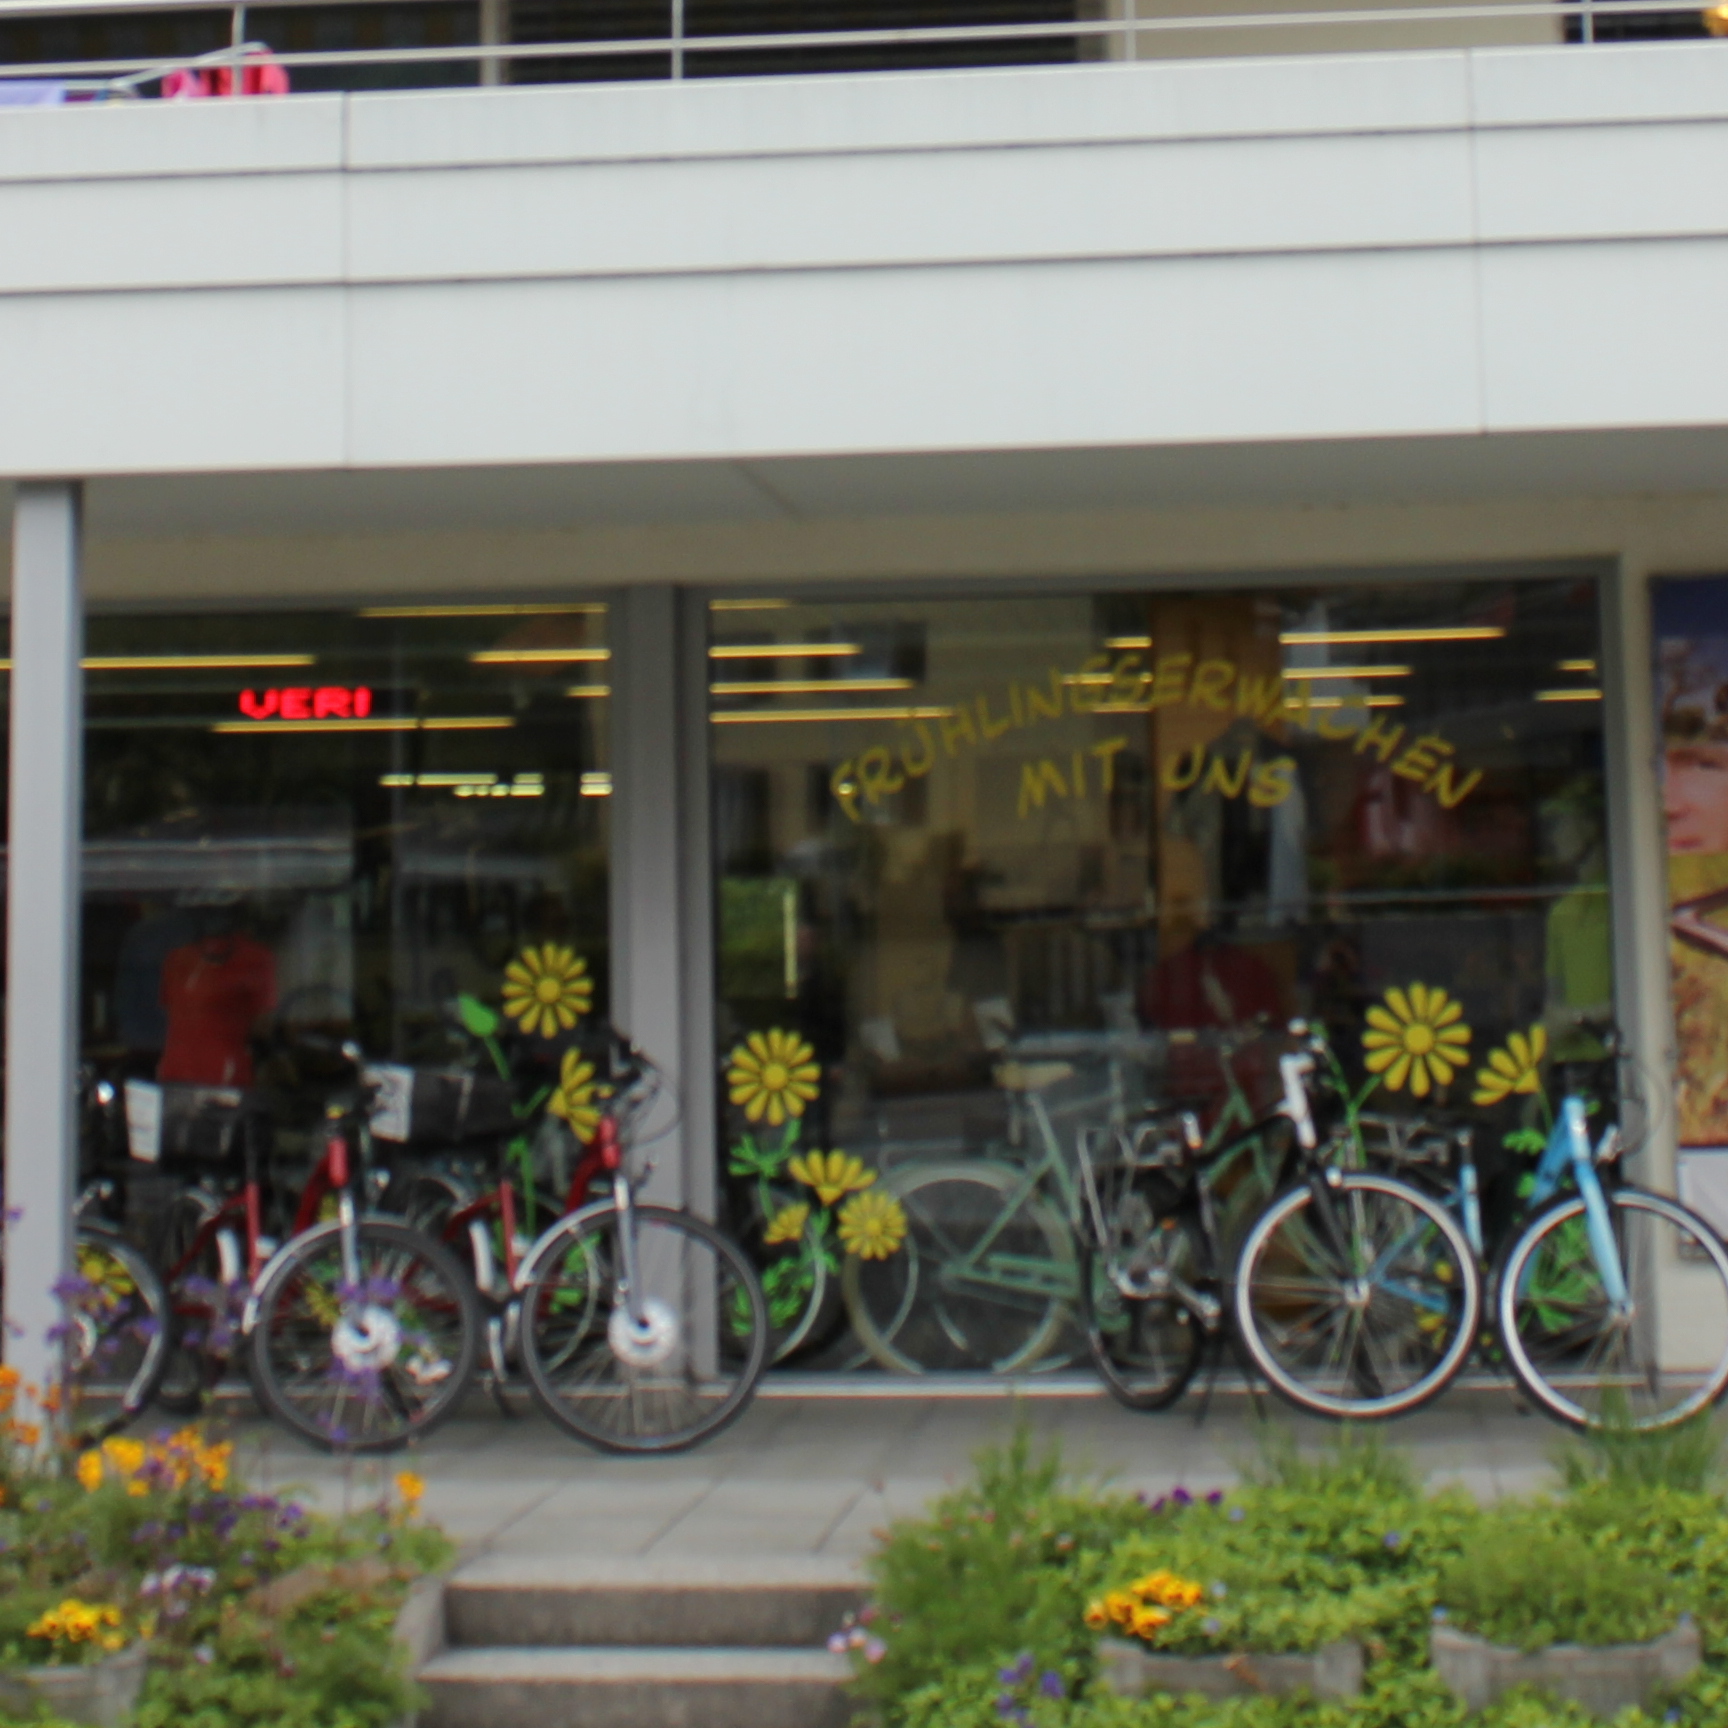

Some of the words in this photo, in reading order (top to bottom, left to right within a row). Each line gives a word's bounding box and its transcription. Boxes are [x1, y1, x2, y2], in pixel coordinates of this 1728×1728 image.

[238, 686, 371, 720] VERI
[1016, 736, 1129, 820] MIT
[1162, 742, 1298, 808] UNS
